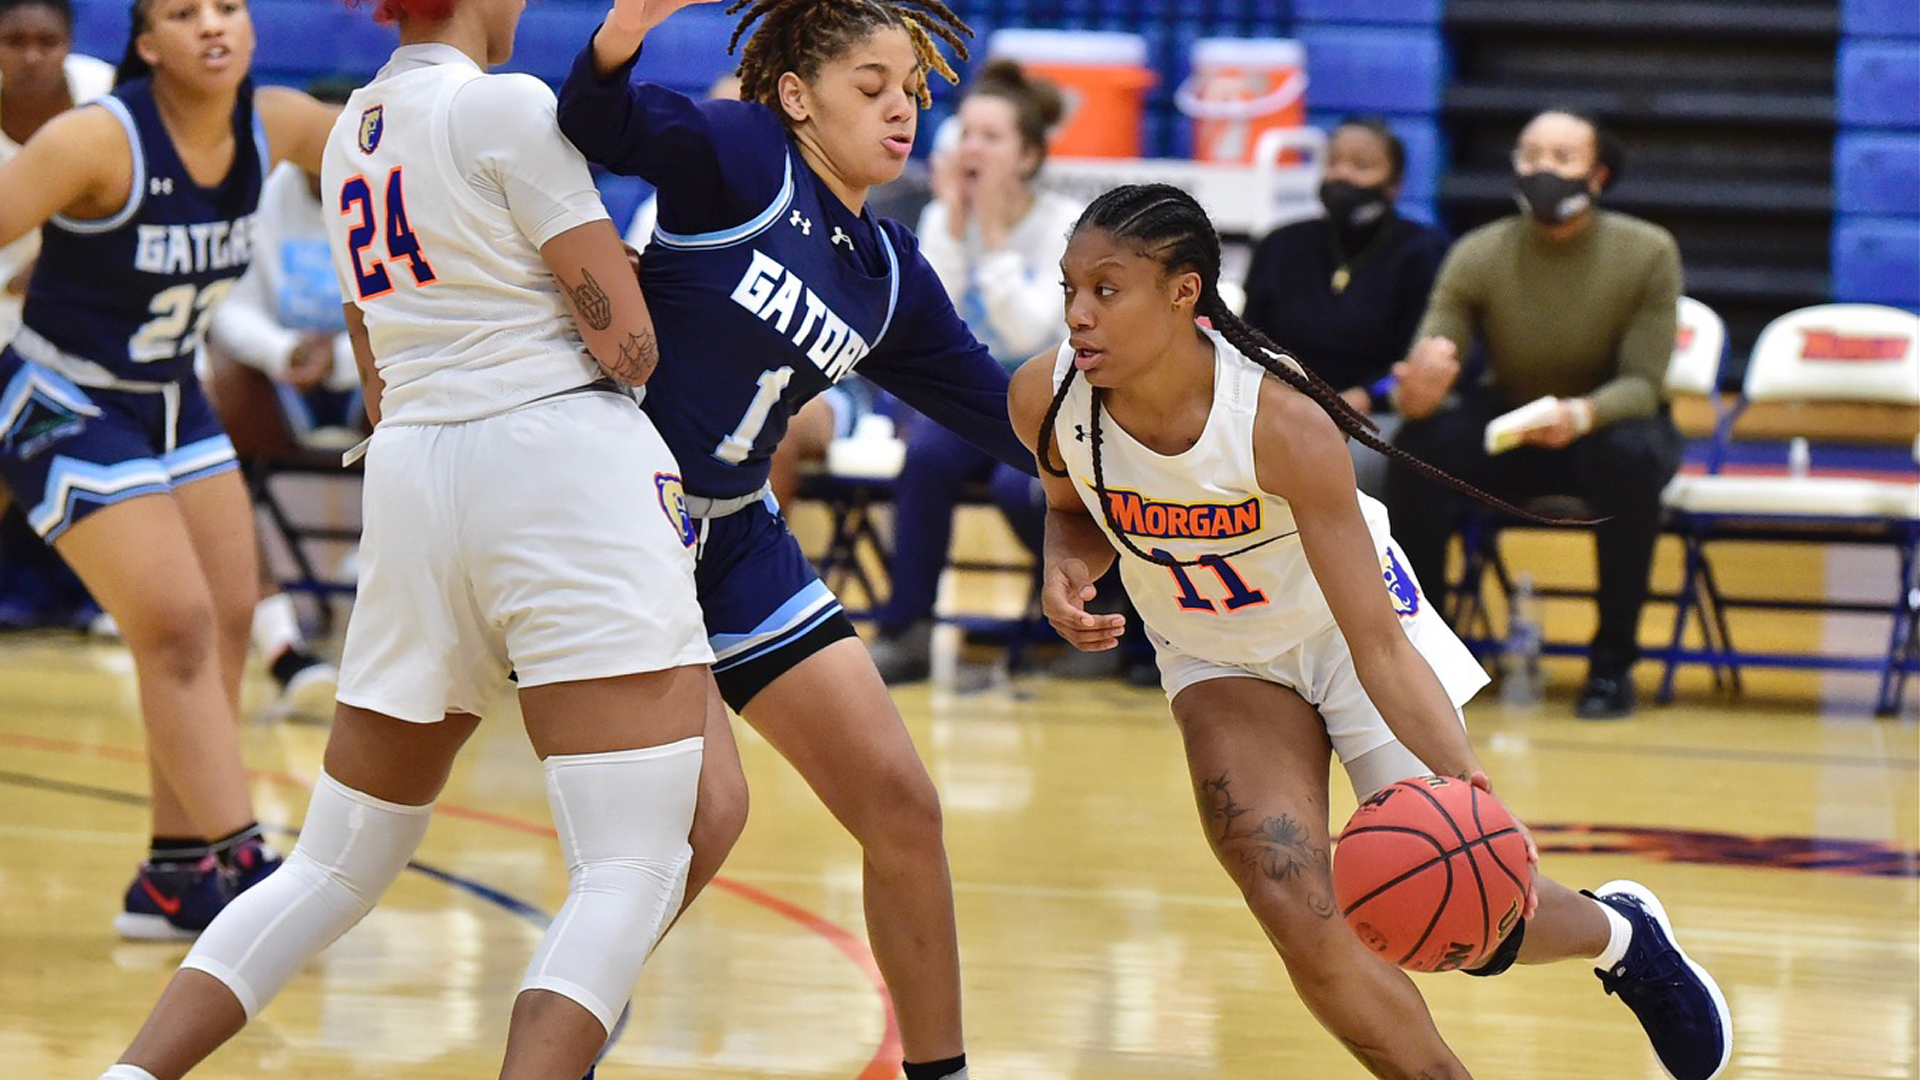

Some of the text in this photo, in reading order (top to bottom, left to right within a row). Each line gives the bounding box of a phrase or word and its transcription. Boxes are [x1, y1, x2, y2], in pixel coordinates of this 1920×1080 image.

[340, 165, 437, 301] 24
[730, 248, 870, 385] GATOR
[711, 365, 796, 467] 1
[1105, 491, 1260, 538] MORGAN
[1148, 547, 1269, 615] 11
